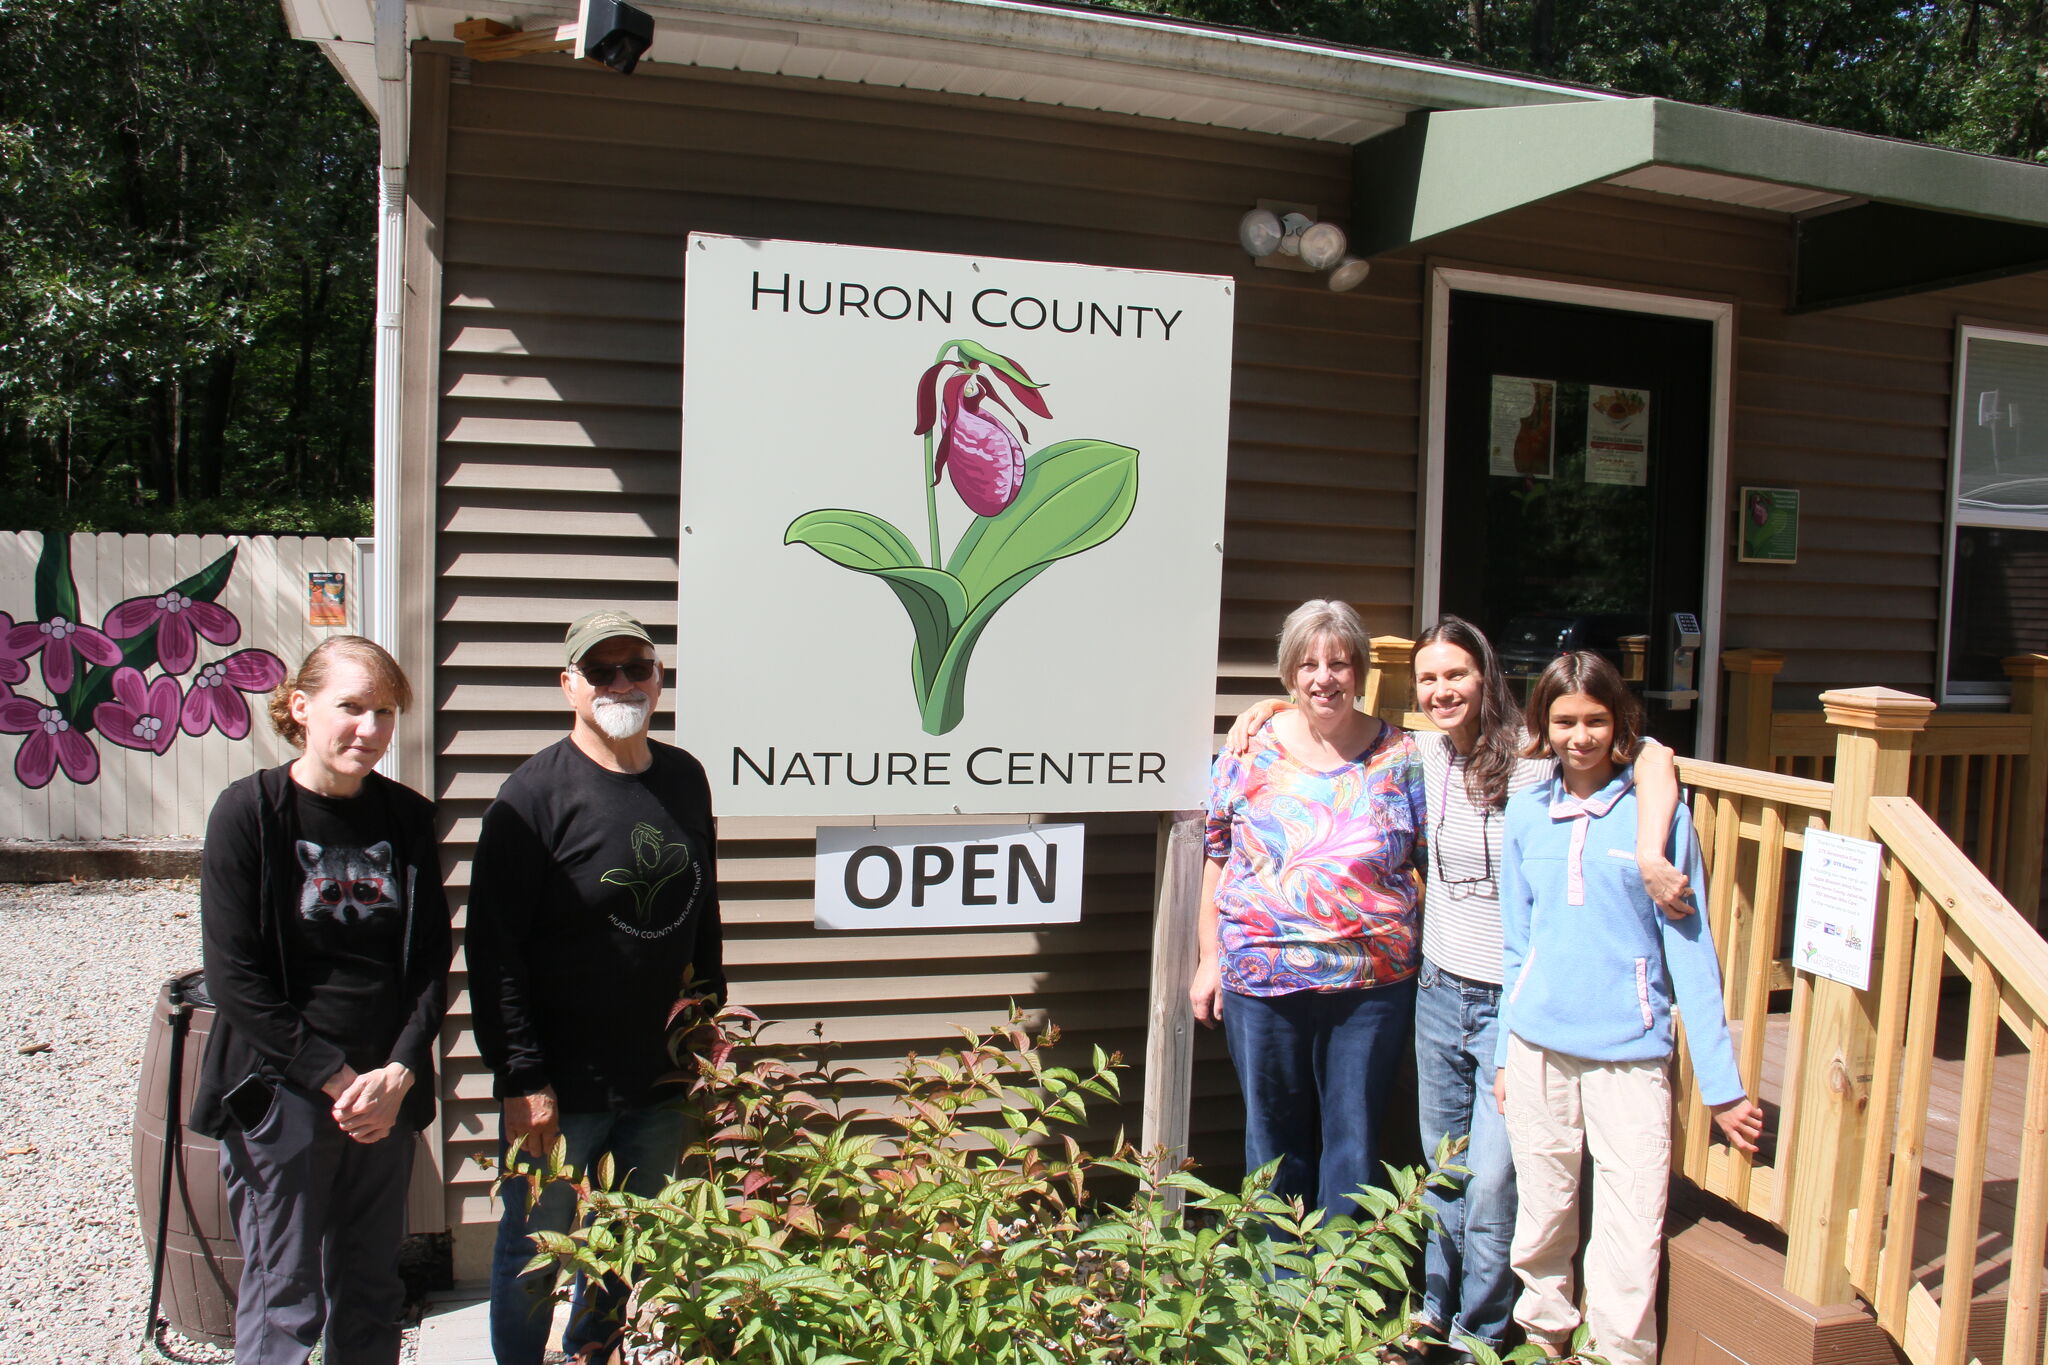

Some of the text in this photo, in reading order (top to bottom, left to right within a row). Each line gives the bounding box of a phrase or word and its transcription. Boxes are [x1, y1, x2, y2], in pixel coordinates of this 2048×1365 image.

[751, 271, 1183, 341] HURON COUNTY
[732, 746, 1167, 786] NATURE CENTER
[844, 843, 1057, 909] OPEN
[1842, 863, 1857, 872] Energy
[608, 914, 640, 937] HURON
[640, 925, 674, 939] COUNTY
[674, 897, 696, 928] NATURE
